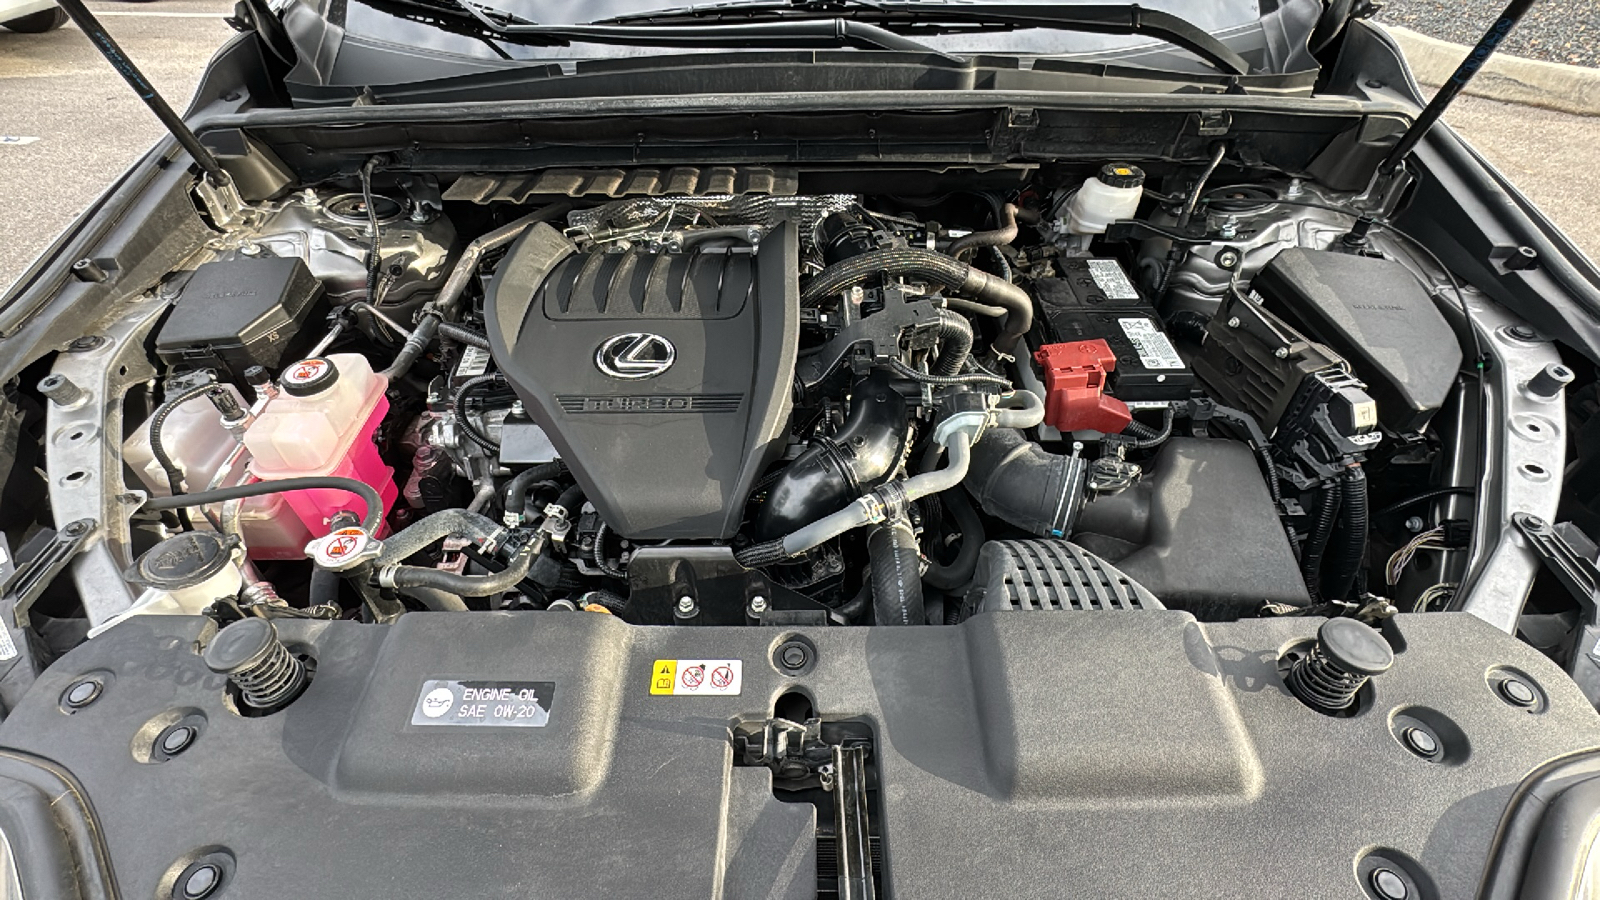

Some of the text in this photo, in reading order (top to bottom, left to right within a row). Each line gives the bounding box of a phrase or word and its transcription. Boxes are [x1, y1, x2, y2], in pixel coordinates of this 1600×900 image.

[584, 397, 692, 411] TURBO
[462, 688, 539, 702] ENGINE OIL
[458, 704, 488, 718] SAE
